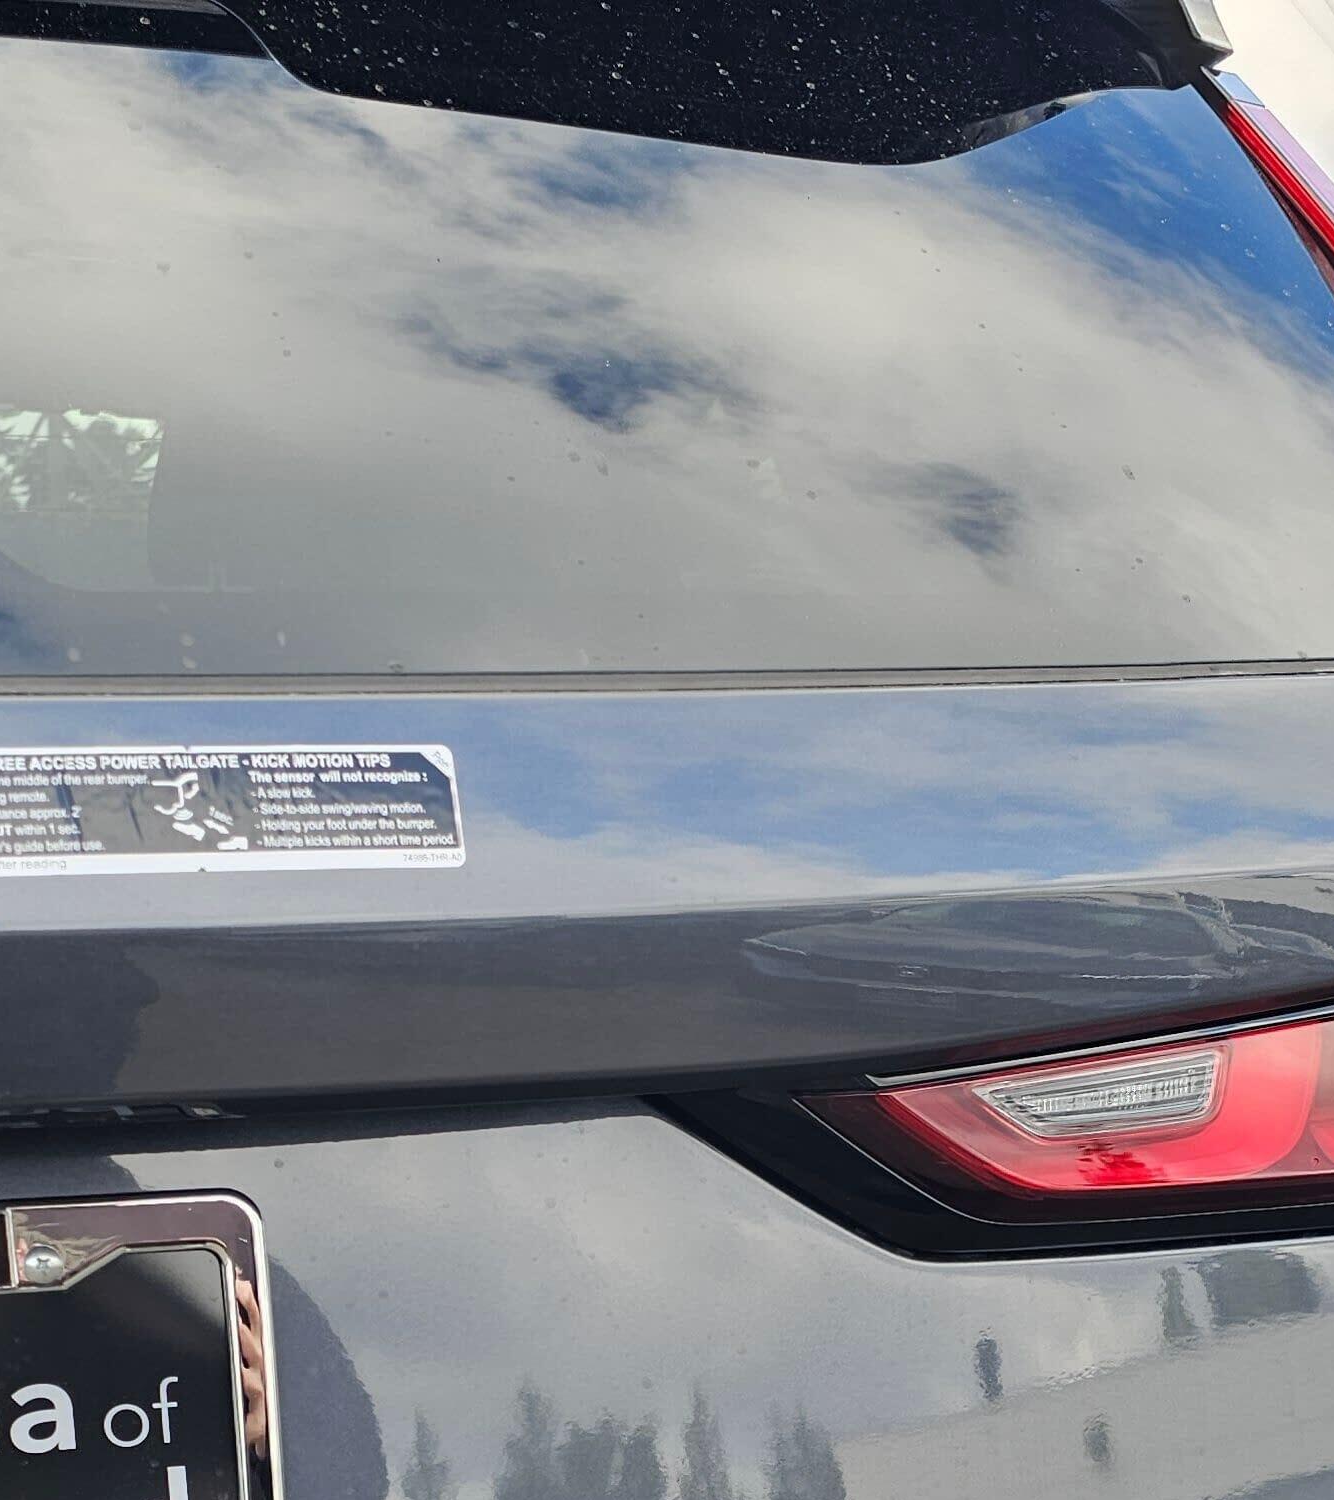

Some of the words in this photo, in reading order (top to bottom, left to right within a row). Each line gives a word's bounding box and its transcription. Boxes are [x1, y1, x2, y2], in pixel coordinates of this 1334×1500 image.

[29, 755, 97, 771] ACCESS
[99, 754, 161, 770] POWER
[162, 753, 240, 769] TAILGATE
[250, 753, 291, 769] KICK
[292, 753, 354, 769] MOTION
[355, 753, 392, 768] TIPS
[13, 774, 49, 787] middle
[51, 772, 63, 786] of
[64, 774, 82, 786] the
[83, 774, 106, 785] rear
[248, 770, 271, 784] The
[273, 773, 316, 783] sensor
[319, 770, 341, 783] will
[342, 772, 364, 783] not
[267, 787, 291, 799] slow
[259, 802, 321, 815] Side-to-side
[389, 802, 427, 814] motion.
[13, 825, 47, 836] within
[261, 819, 302, 833] Holding
[302, 820, 326, 833] your
[326, 818, 348, 830] foot
[348, 818, 377, 830] under
[378, 818, 395, 830] the
[396, 818, 437, 831] bumper.
[13, 840, 44, 856] guide
[45, 839, 81, 853] before
[263, 835, 304, 849] Multiple
[304, 834, 331, 848] kicks
[332, 834, 362, 847] within
[373, 834, 399, 847] short
[399, 834, 421, 846] time
[103, 1375, 180, 1448] of
